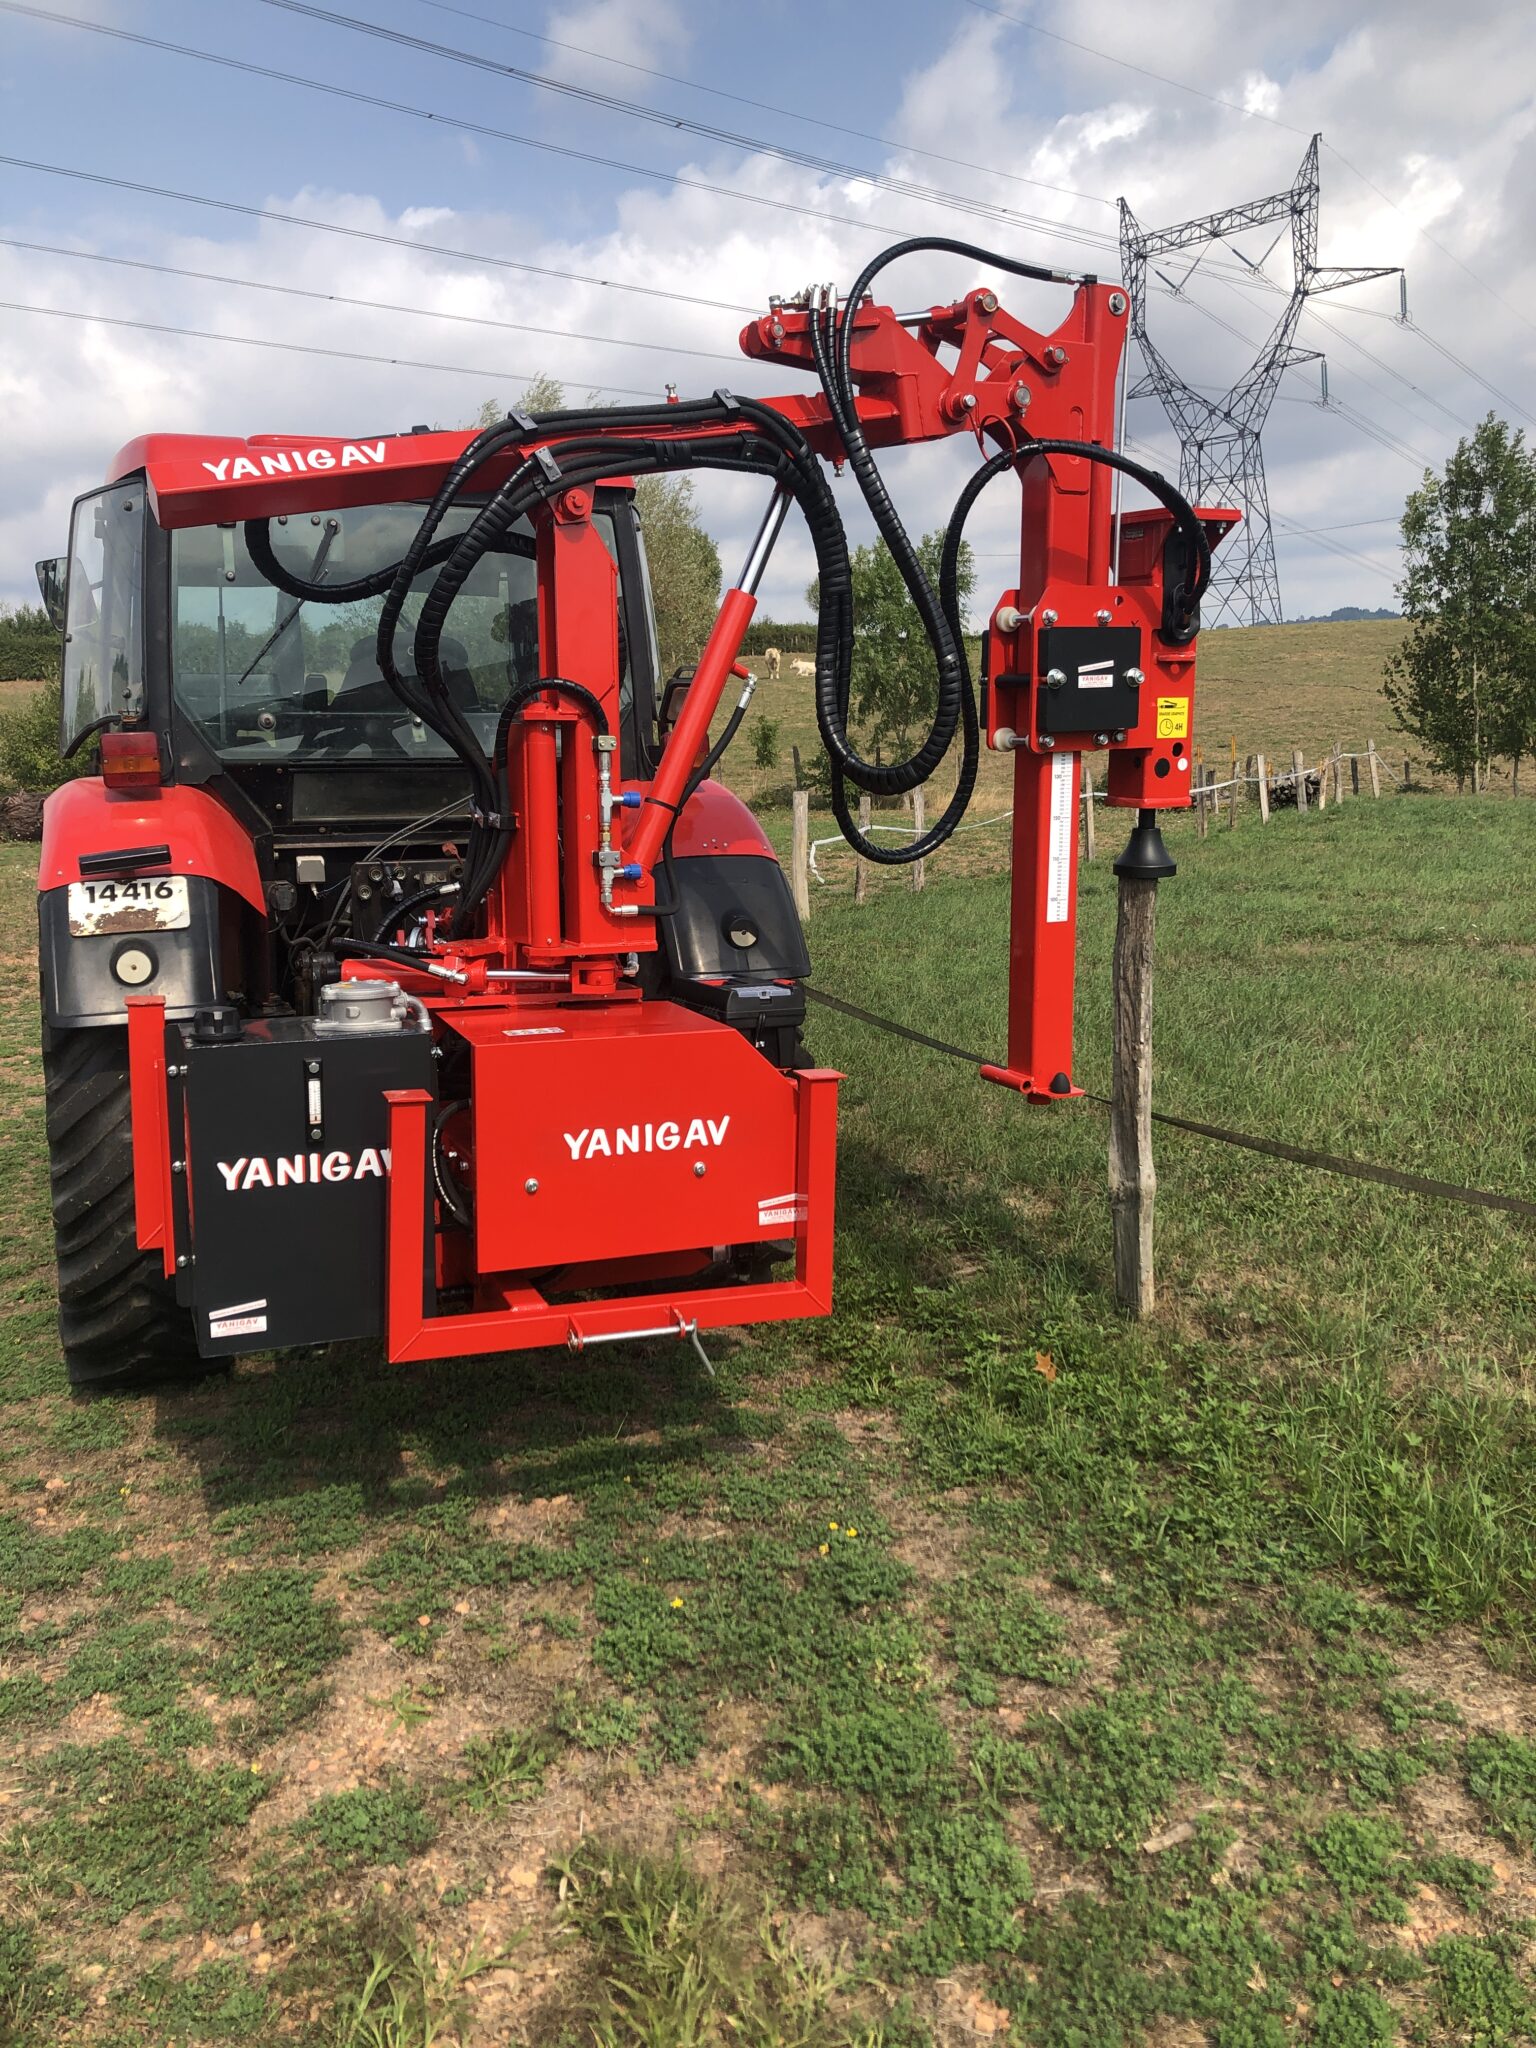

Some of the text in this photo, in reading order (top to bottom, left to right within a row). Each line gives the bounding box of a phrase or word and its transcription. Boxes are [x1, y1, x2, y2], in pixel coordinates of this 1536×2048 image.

[202, 441, 385, 481] YANIGAV
[1174, 722, 1183, 731] 4H
[563, 1115, 730, 1160] YANIGAV
[217, 1318, 258, 1329] YANIGAV
